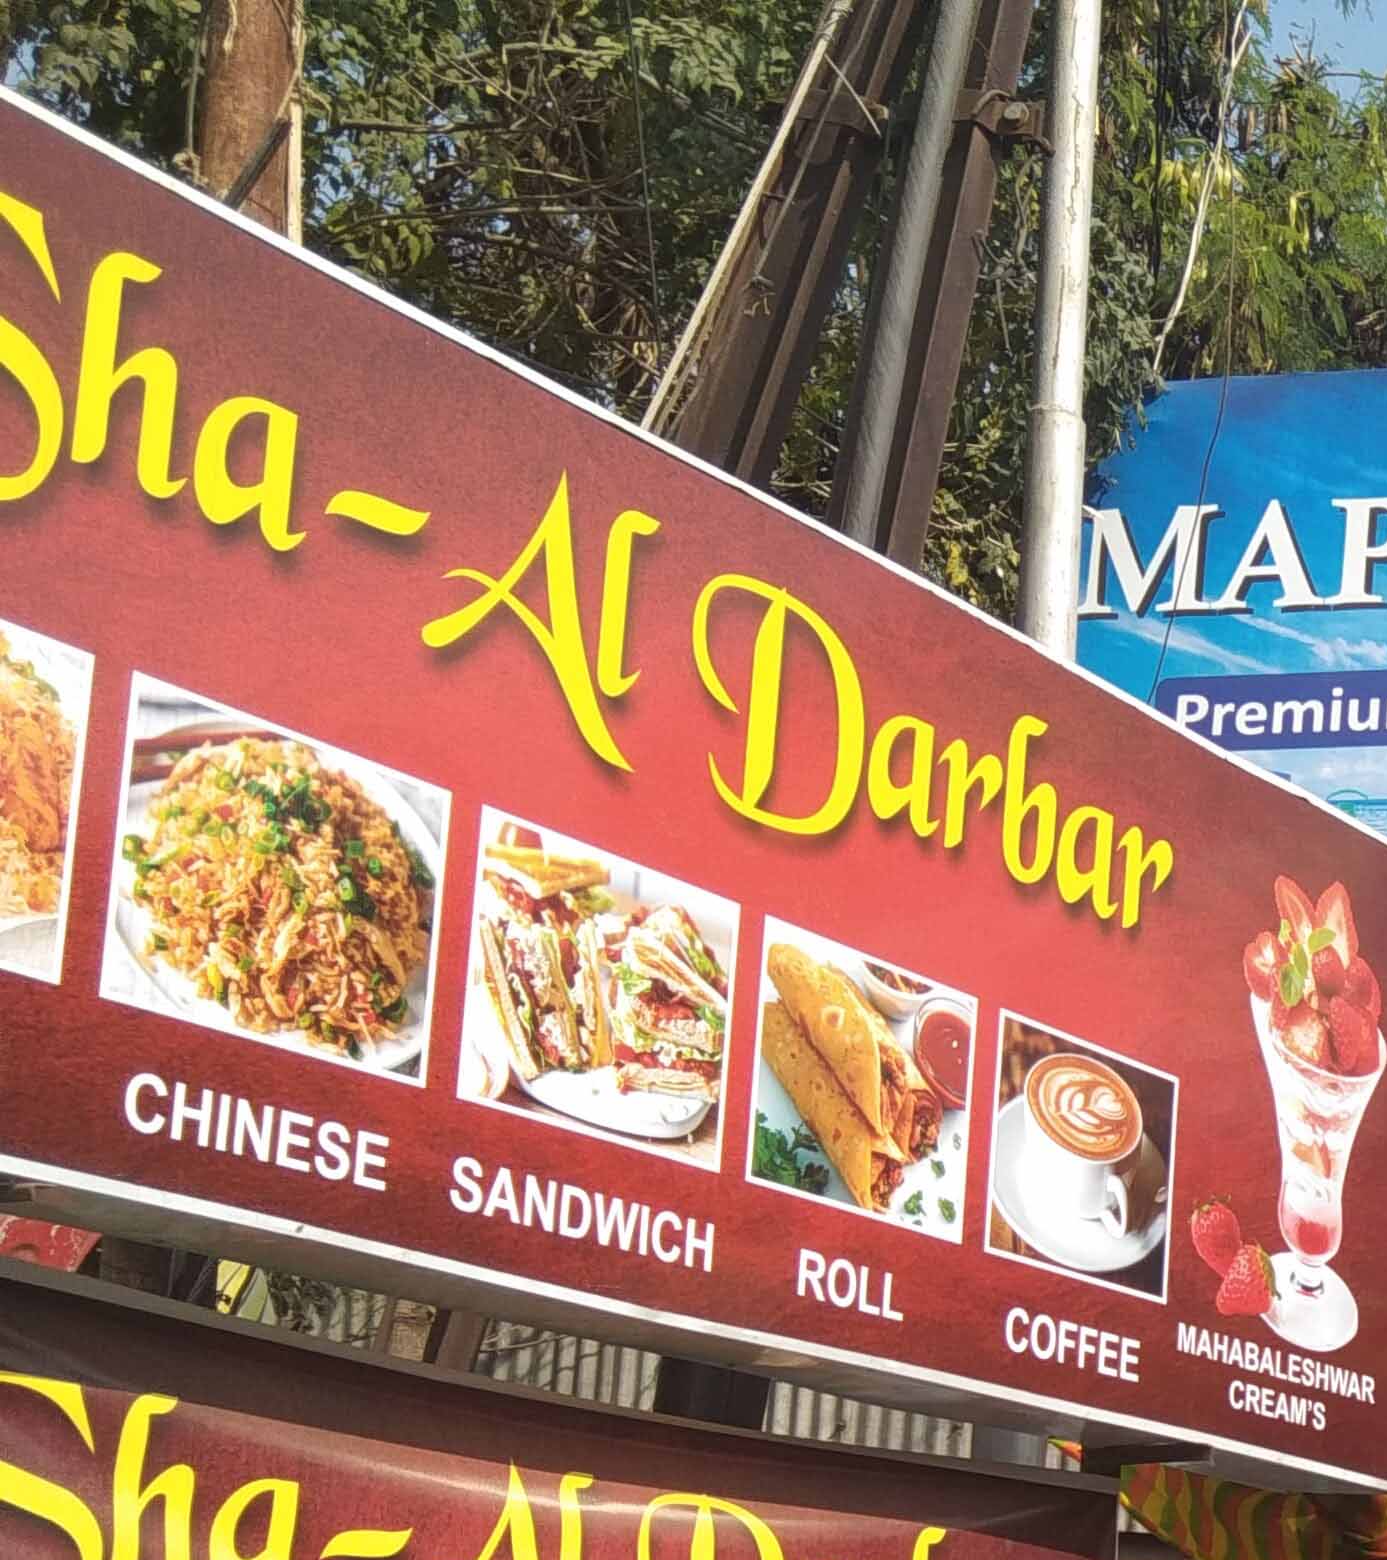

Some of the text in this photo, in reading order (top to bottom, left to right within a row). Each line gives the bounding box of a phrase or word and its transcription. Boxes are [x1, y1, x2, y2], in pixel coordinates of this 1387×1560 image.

[692, 574, 1174, 929] Darbar
[124, 1072, 390, 1192] CHINESE
[449, 1156, 715, 1273] SANDWICH
[797, 1248, 904, 1321] ROLL
[1005, 1306, 1142, 1383] COFFEE
[1177, 1322, 1375, 1404] MAHABALESHWAR
[1229, 1380, 1327, 1431] CREAM'S
